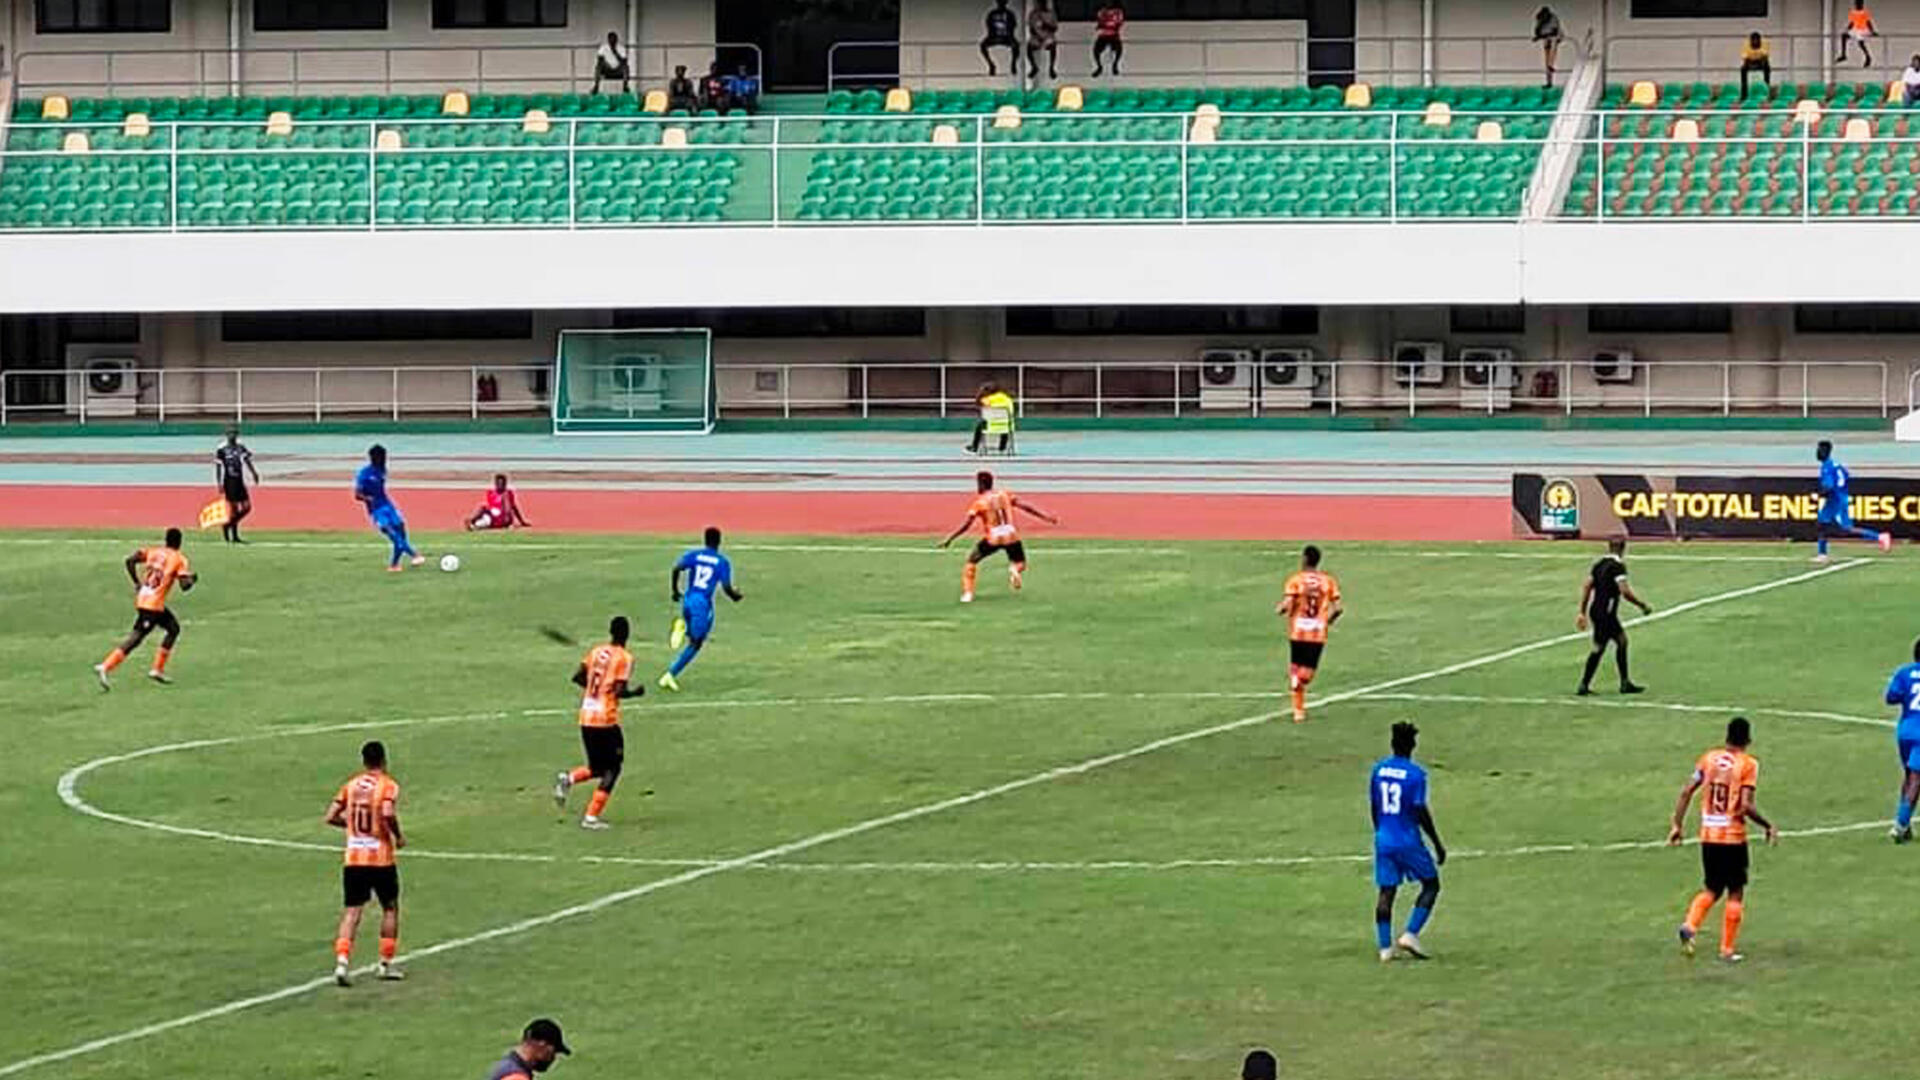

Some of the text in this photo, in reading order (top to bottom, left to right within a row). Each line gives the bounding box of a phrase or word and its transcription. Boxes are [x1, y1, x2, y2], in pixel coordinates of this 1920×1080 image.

[1613, 492, 1920, 520] CAF TOTAL ENEIES C
[694, 565, 713, 589] 12
[1380, 781, 1401, 814] 13
[1708, 781, 1729, 813] 19
[351, 802, 372, 834] 10
